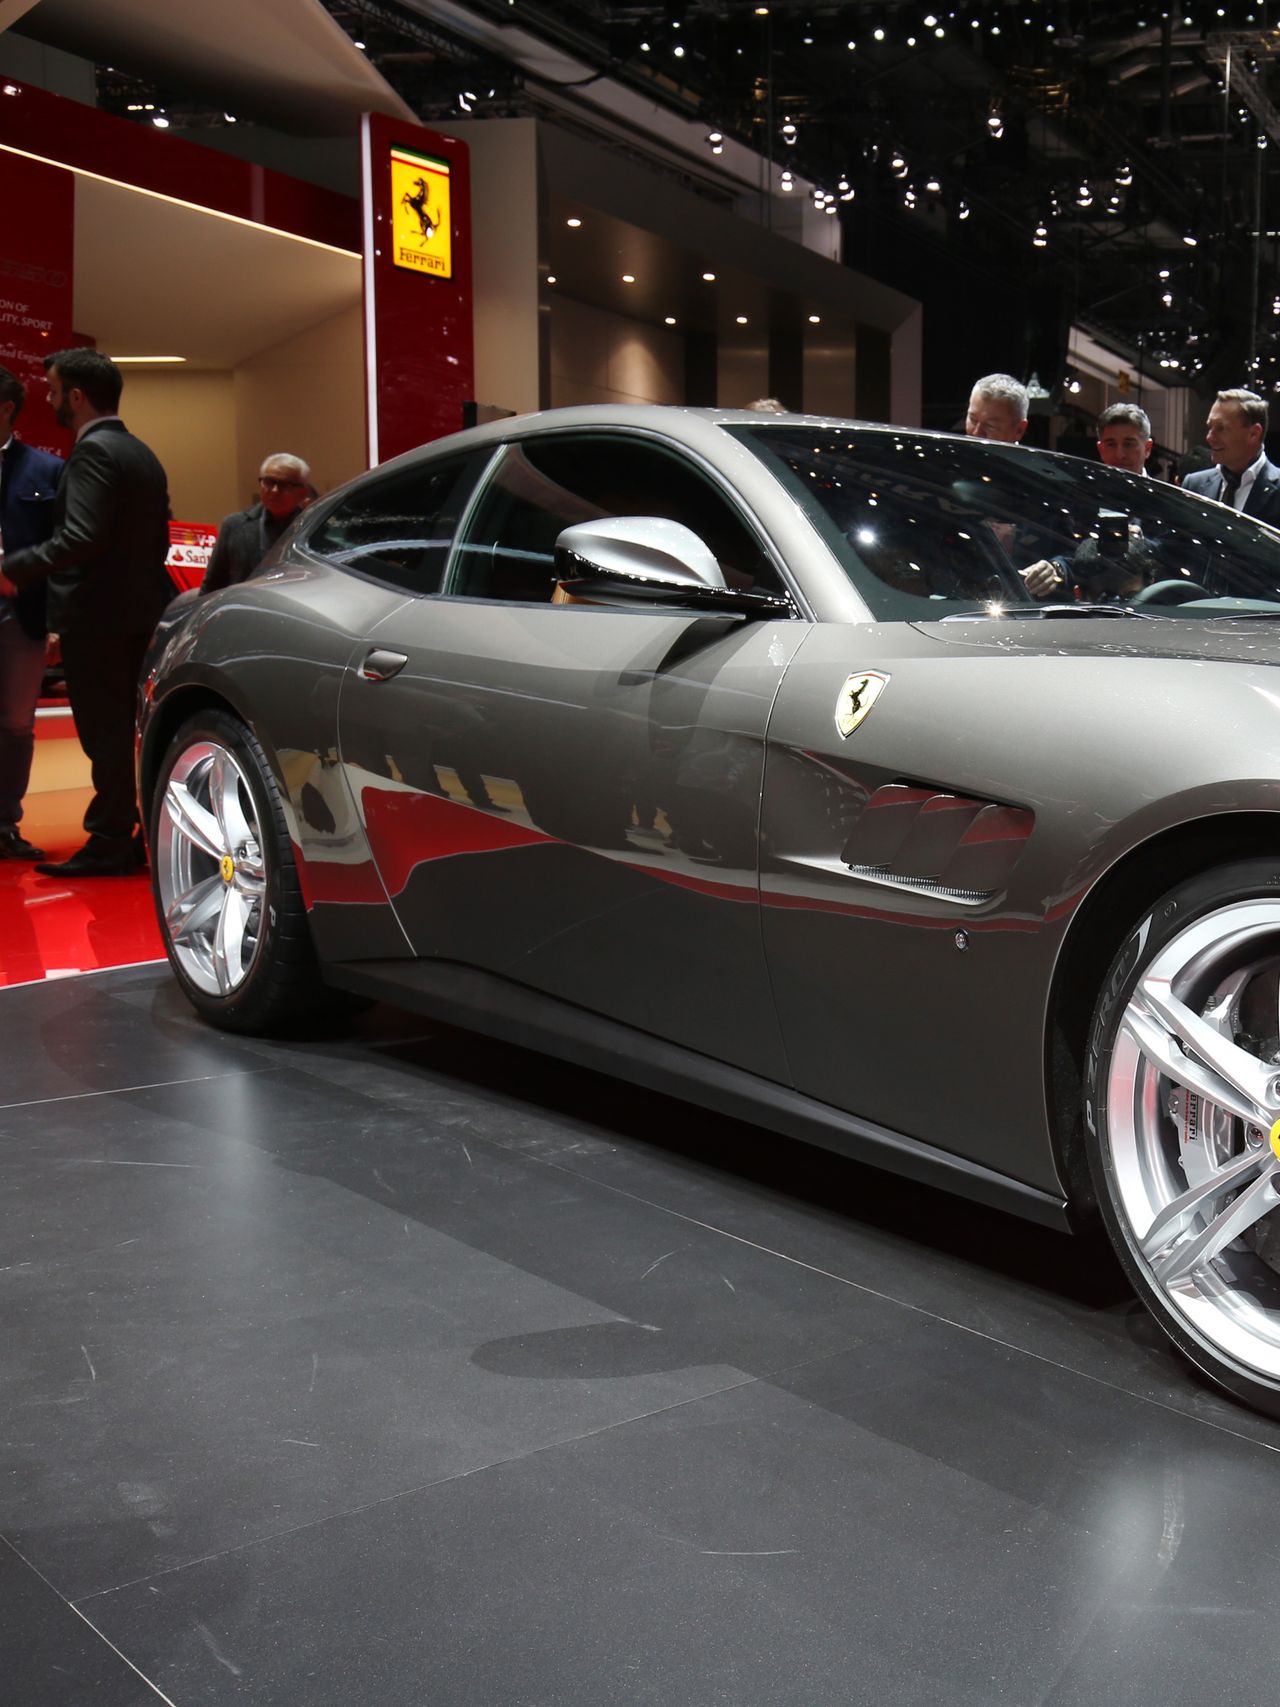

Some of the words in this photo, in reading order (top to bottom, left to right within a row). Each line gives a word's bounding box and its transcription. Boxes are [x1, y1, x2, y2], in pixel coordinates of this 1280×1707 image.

[399, 247, 446, 272] Ferrari
[15, 302, 30, 313] OF
[21, 317, 54, 331] SPORT
[1188, 1094, 1199, 1141] errari
